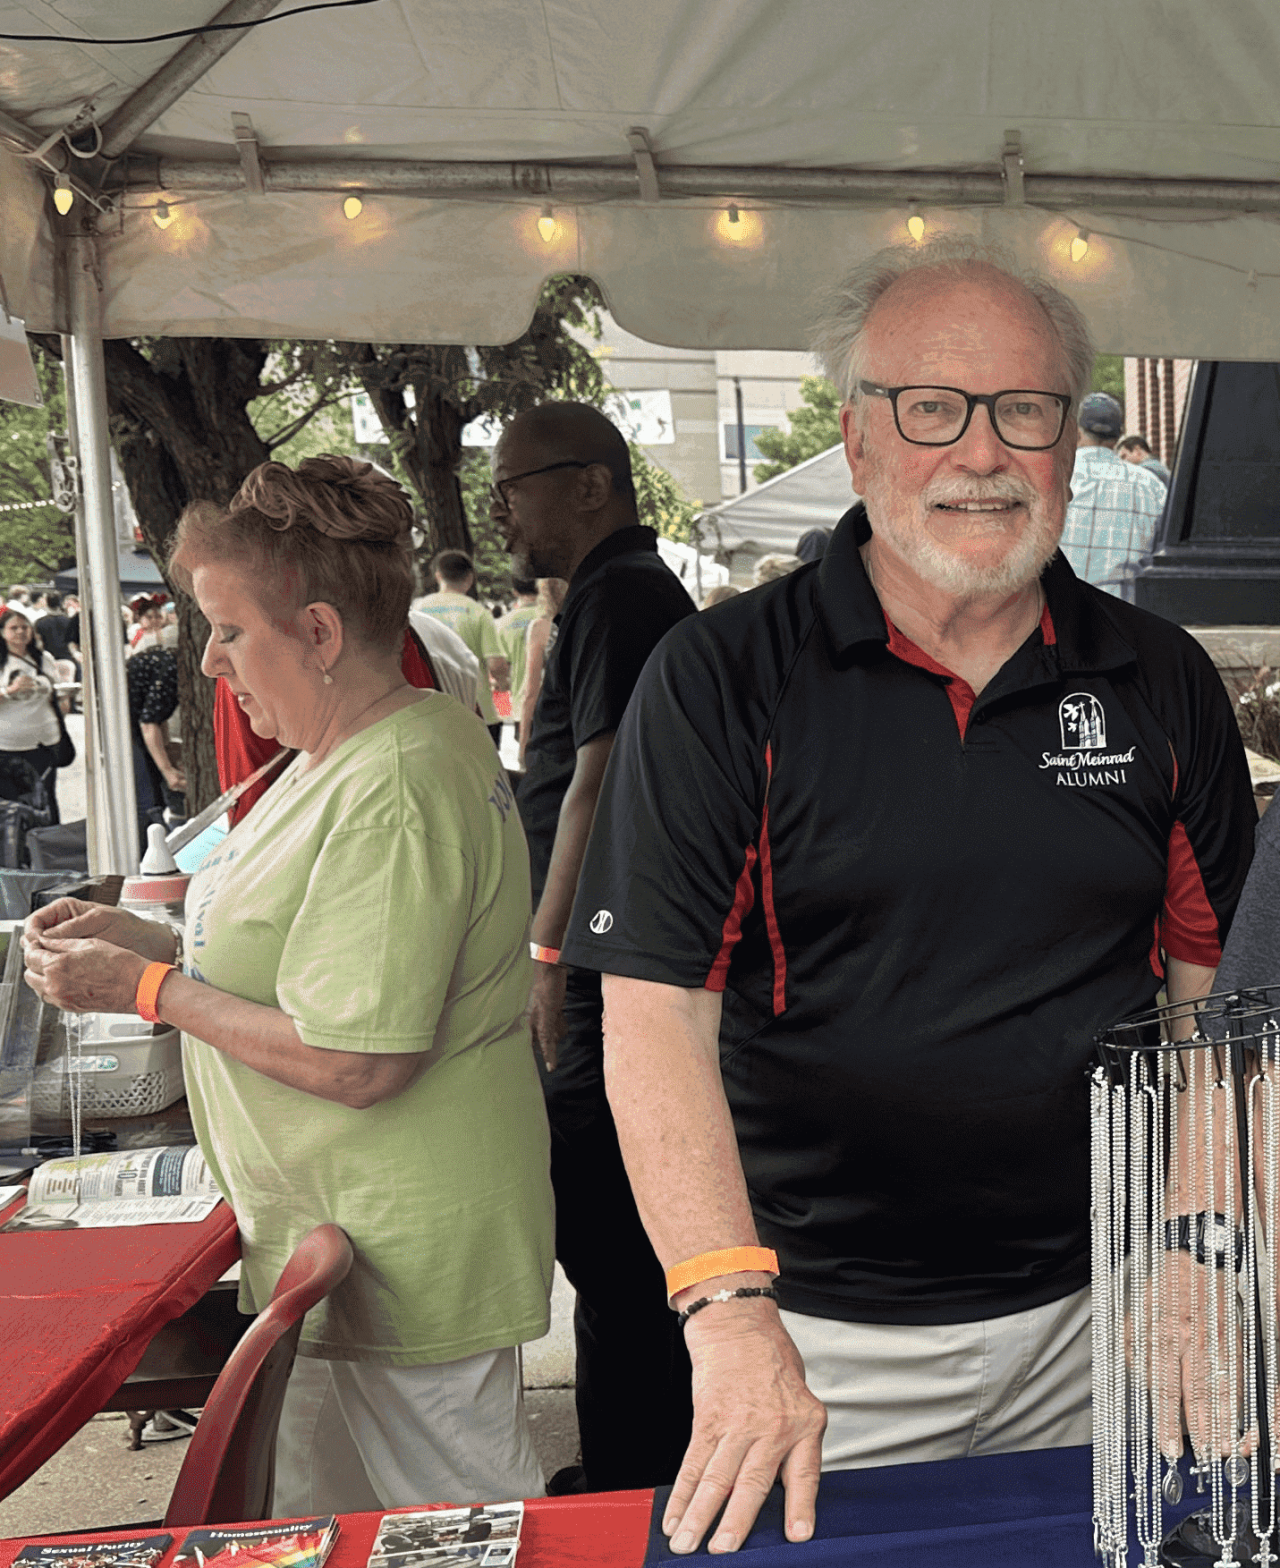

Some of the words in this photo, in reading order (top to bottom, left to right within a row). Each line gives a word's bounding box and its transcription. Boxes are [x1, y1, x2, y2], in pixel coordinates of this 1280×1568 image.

[1038, 751, 1076, 769] Saint
[1071, 745, 1136, 770] Meinrad
[1056, 769, 1127, 787] ALUMNI
[209, 1522, 314, 1539] Homosexuality
[40, 1545, 93, 1555] Sexual
[96, 1540, 146, 1552] Purity
